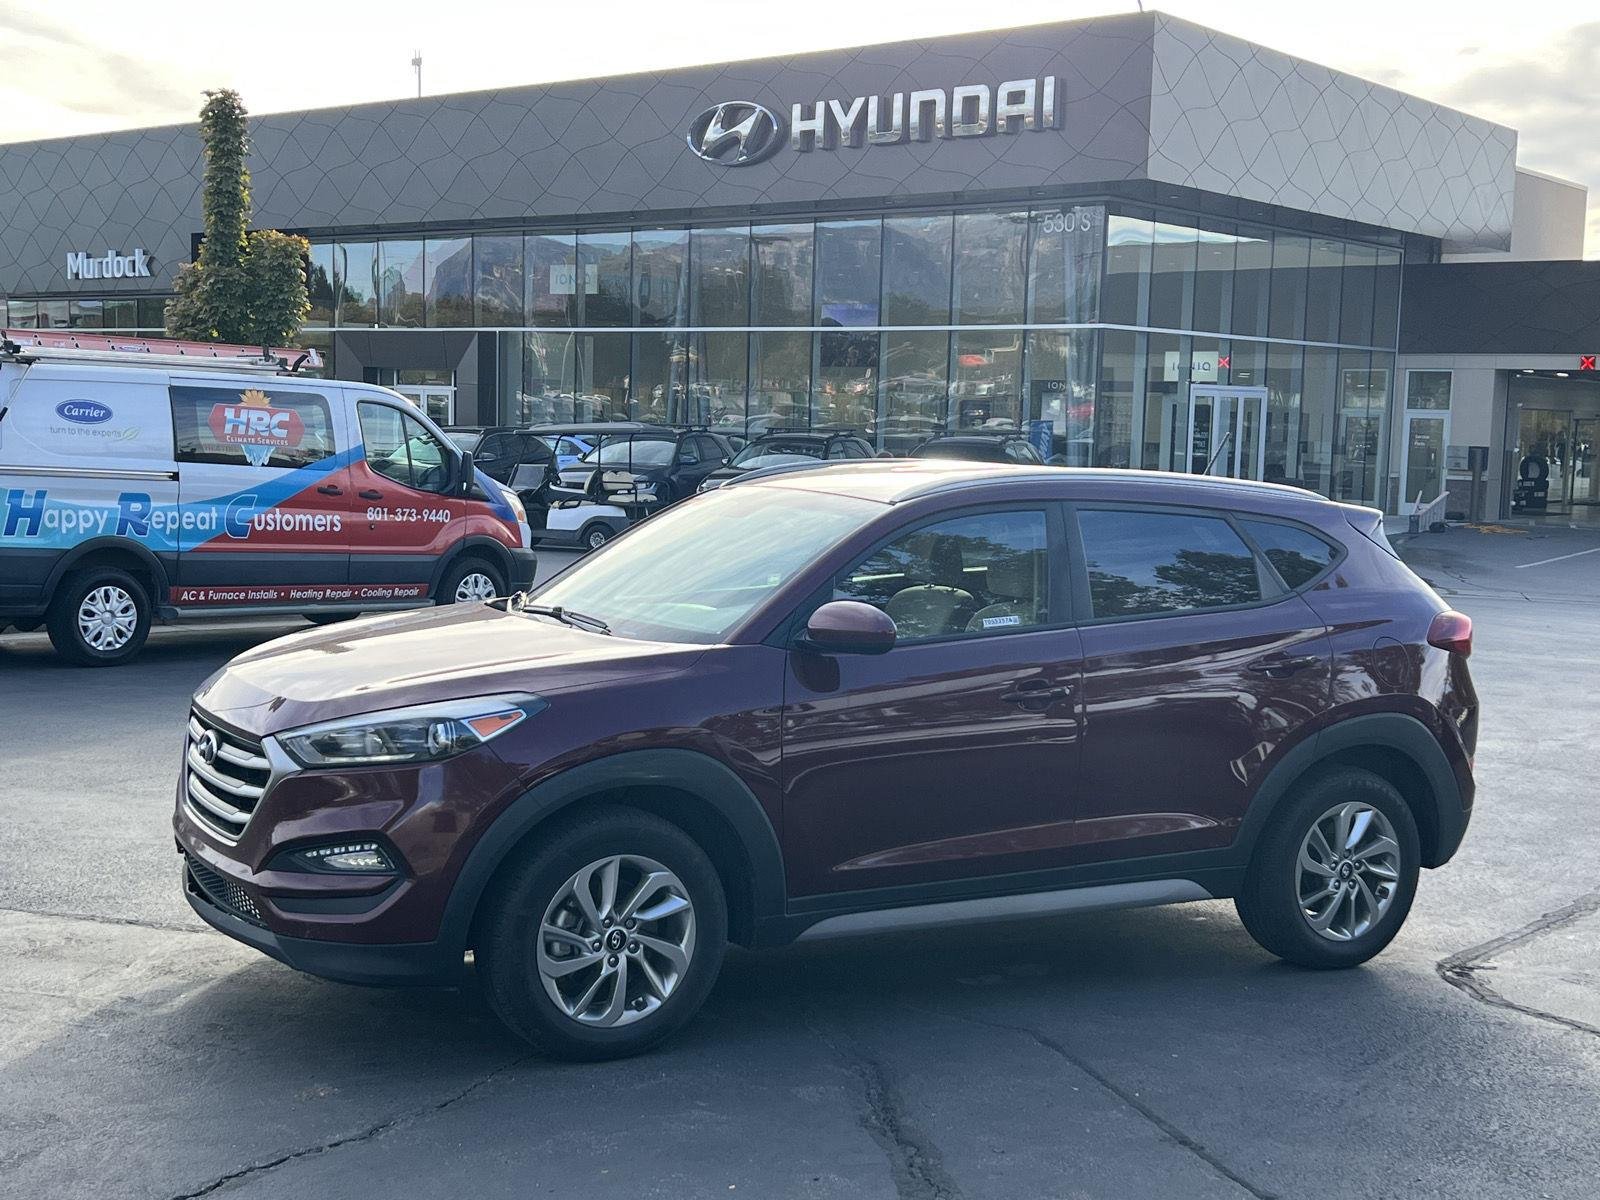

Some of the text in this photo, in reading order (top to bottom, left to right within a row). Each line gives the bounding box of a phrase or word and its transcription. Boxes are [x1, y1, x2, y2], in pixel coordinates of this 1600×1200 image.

[791, 76, 1055, 150] HYUNDAI
[1043, 212, 1091, 233] 530 S
[67, 248, 151, 279] Murdock
[64, 404, 106, 418] Carrier
[50, 426, 122, 439] turn to the experts
[224, 408, 290, 438] HRC
[3, 488, 342, 539] Happy Repeat Customers
[366, 506, 451, 523] 801-373-9440
[181, 587, 420, 601] AC & Furnace Installs Heating Repair Cooling Repair
